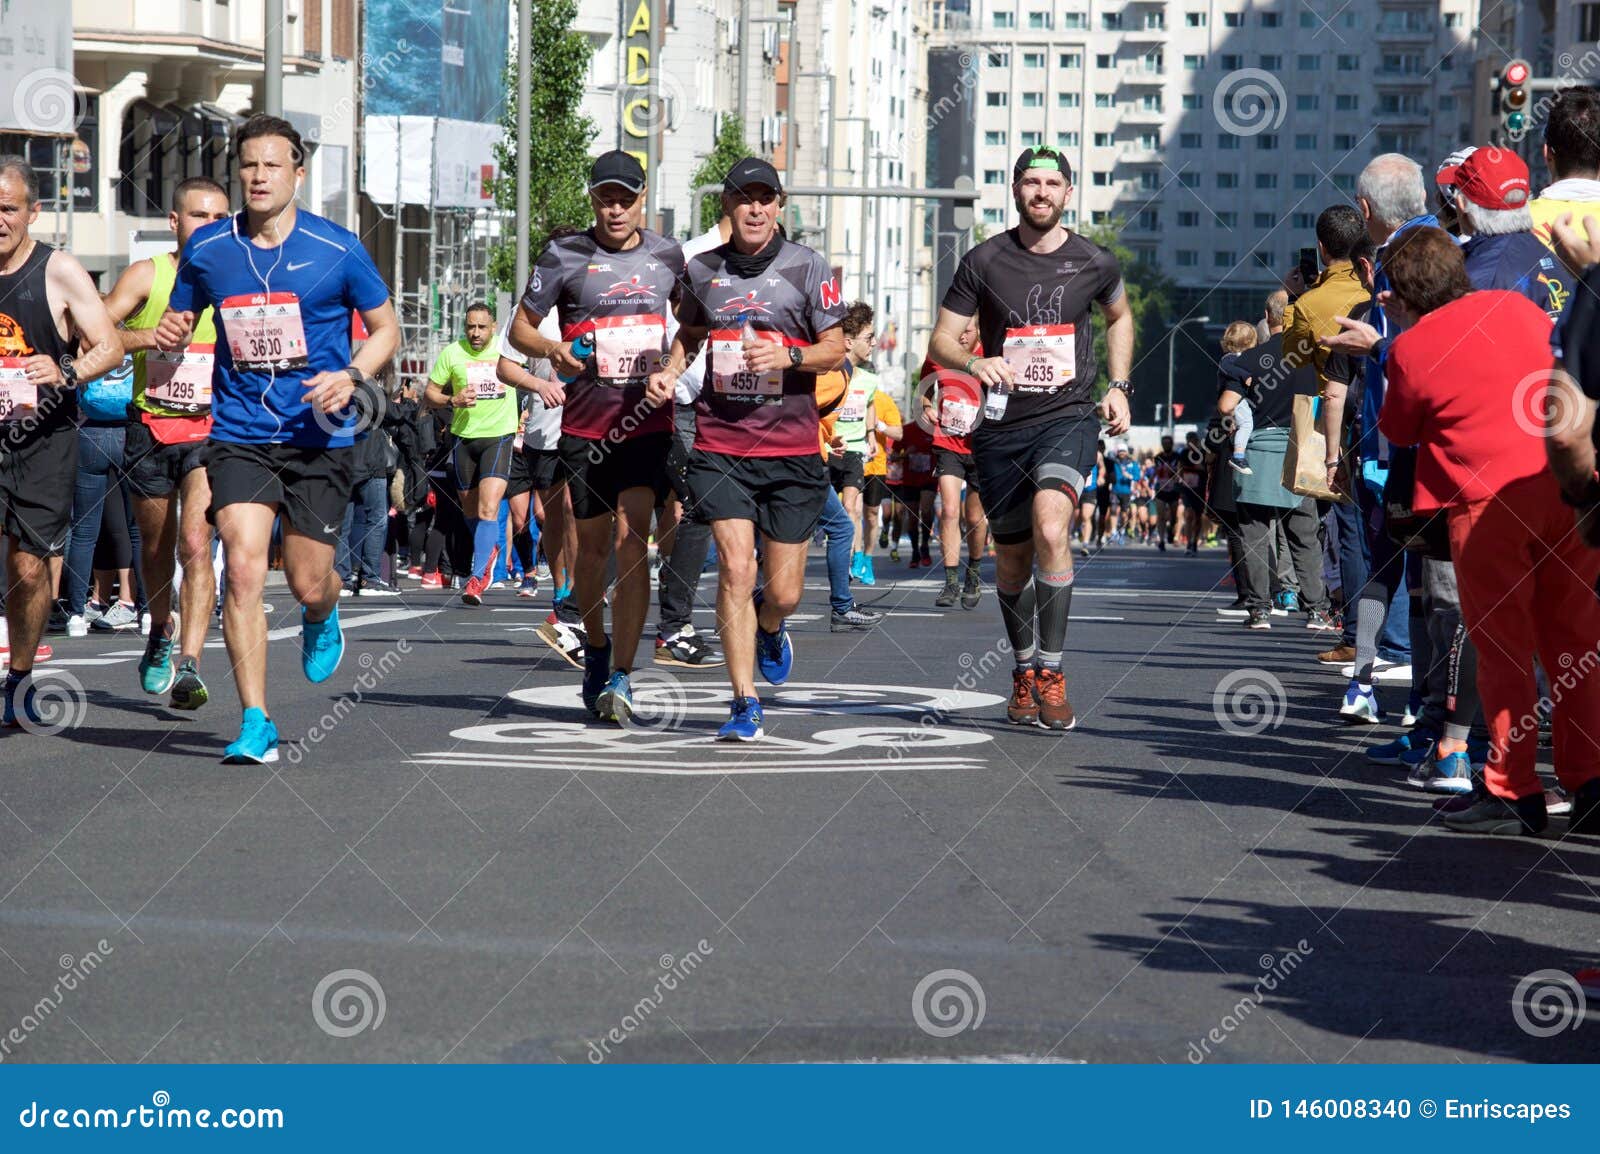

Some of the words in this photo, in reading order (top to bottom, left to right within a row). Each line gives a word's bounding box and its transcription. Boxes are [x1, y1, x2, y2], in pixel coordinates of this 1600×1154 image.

[618, 356, 647, 374] 2716
[1024, 365, 1054, 382] 4635
[166, 380, 195, 400] 1295
[480, 382, 496, 393] 1042
[731, 372, 760, 391] 4557
